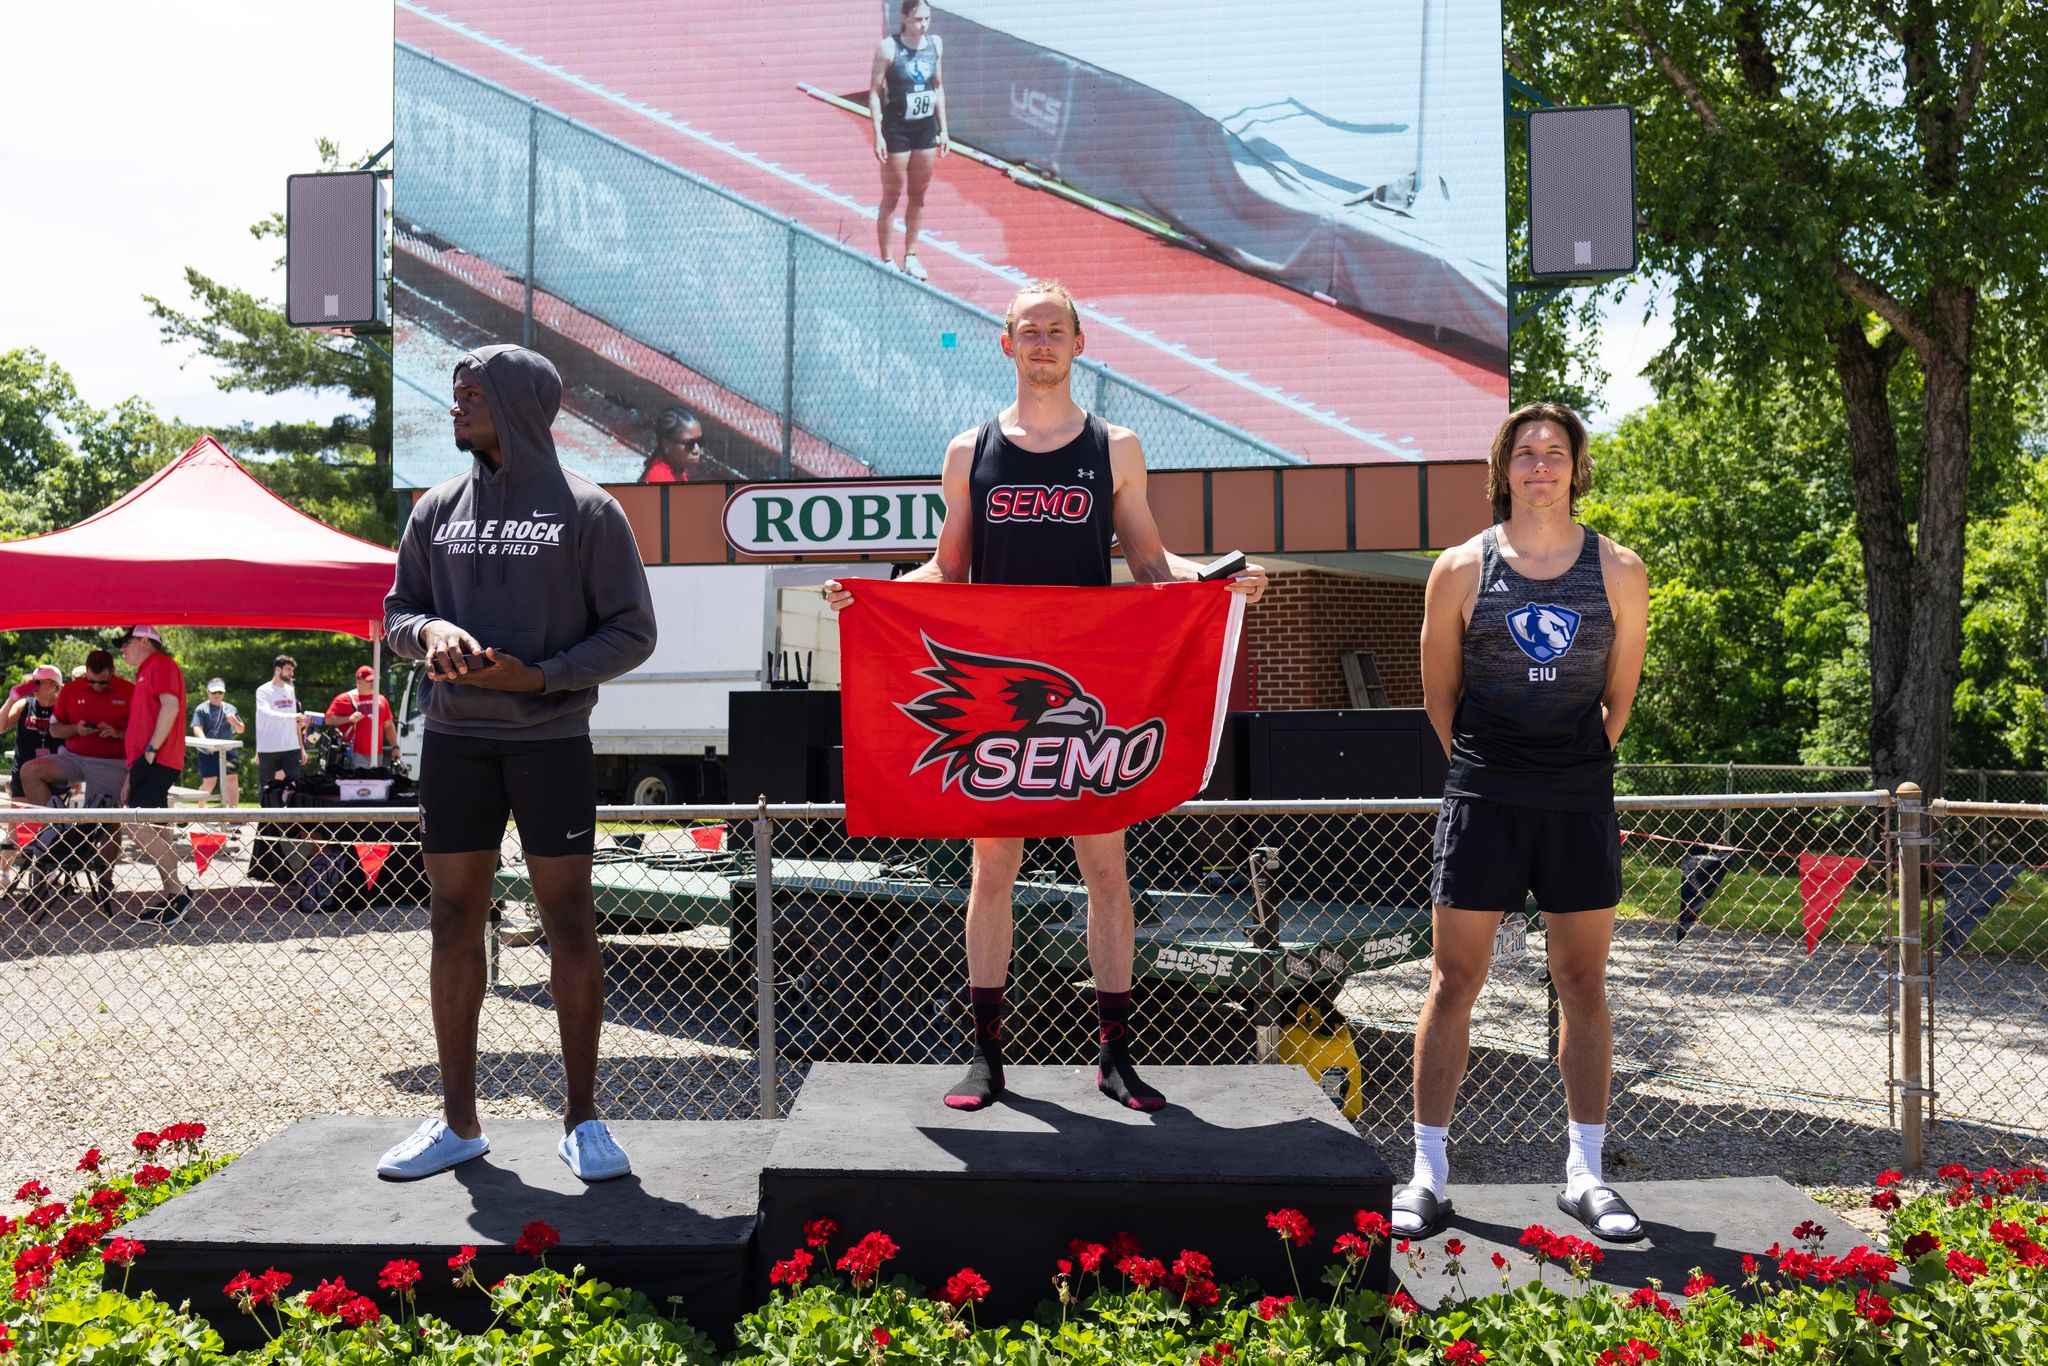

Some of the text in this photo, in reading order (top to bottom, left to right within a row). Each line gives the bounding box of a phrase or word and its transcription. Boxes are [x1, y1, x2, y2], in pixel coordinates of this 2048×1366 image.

[988, 487, 1091, 521] SEMO
[500, 520, 565, 542] ROCK
[447, 544, 539, 556] TRACK & FIELD
[1528, 667, 1556, 682] EIU
[970, 726, 1158, 790] SEMO
